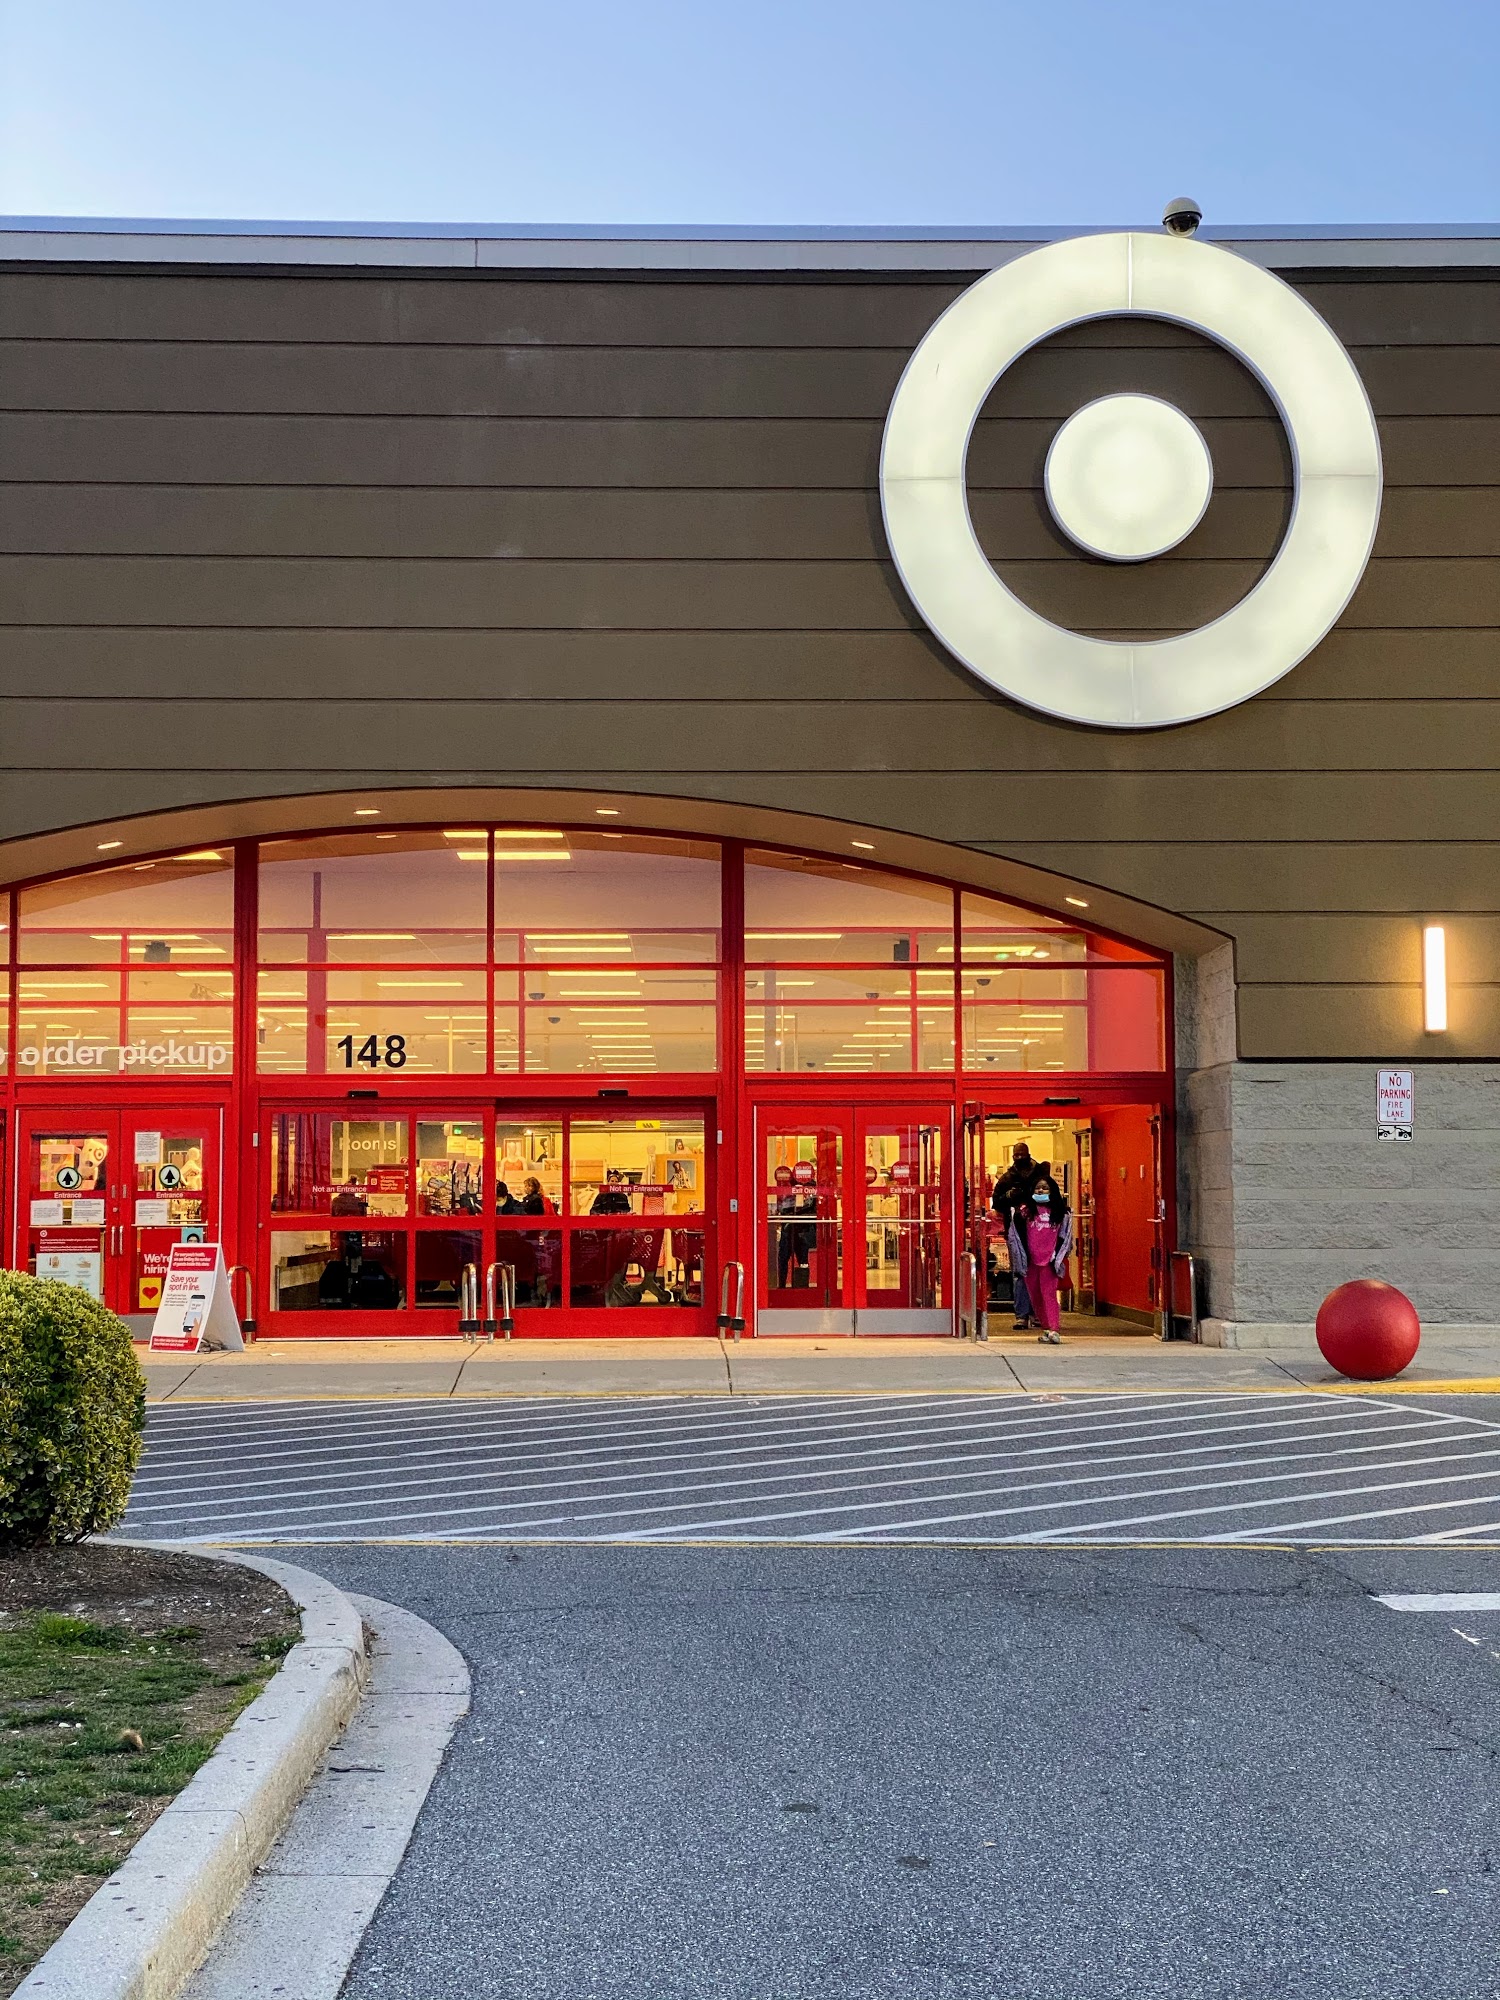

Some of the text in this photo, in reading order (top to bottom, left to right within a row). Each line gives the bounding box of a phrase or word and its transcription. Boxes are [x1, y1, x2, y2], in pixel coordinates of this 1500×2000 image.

[20, 1039, 109, 1066] order
[118, 1038, 227, 1071] pickup
[337, 1034, 407, 1068] 148
[1389, 1077, 1402, 1086] NO
[1381, 1089, 1411, 1099] PARKING
[804, 1187, 818, 1195] Only
[901, 1187, 916, 1195] Only
[170, 1274, 199, 1284] Save your
[168, 1284, 182, 1292] spot
[189, 1283, 200, 1291] line.
